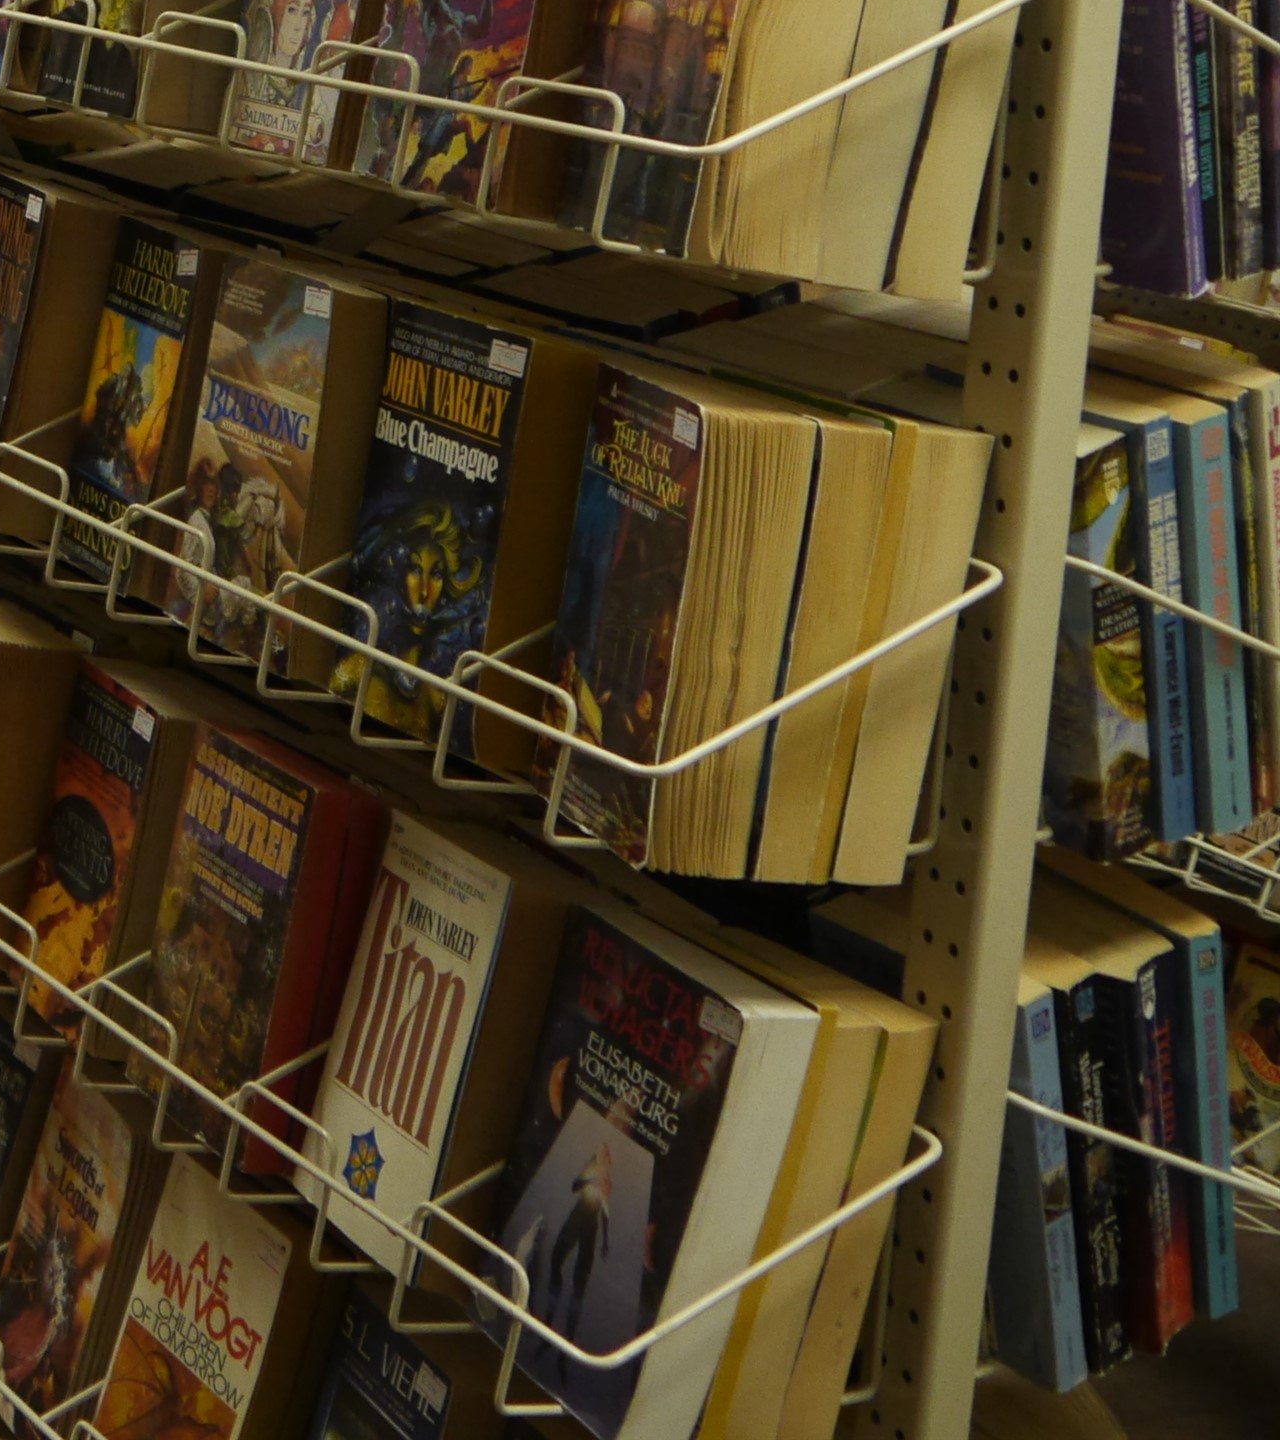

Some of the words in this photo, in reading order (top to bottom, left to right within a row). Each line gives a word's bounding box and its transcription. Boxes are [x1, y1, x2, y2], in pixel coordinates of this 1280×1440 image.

[239, 103, 280, 130] SALINDA
[113, 264, 190, 320] TURTLEDOVE
[202, 375, 312, 451] BLUESONG
[382, 351, 432, 412] JOHN
[432, 366, 512, 440] VARLEY
[375, 406, 408, 449] Blue
[408, 420, 500, 485] Champagne
[612, 418, 639, 454] THE
[78, 479, 108, 510] JAWS
[1162, 620, 1181, 692] Lawrence
[196, 743, 306, 826] ASSIGNMENT
[406, 897, 436, 935] JOHN
[436, 913, 479, 961] VARLEY
[334, 865, 467, 1150] Titan
[578, 1047, 680, 1136] VONARBURG
[587, 1030, 681, 1110] ELISABETH
[55, 1126, 97, 1190] Swords
[57, 1165, 100, 1233] Legion
[146, 1237, 193, 1311] VAN
[192, 1279, 263, 1371] VOGT
[156, 1297, 228, 1372] CHILDREN
[131, 1297, 152, 1321] OF
[150, 1311, 244, 1410] TOMORROW
